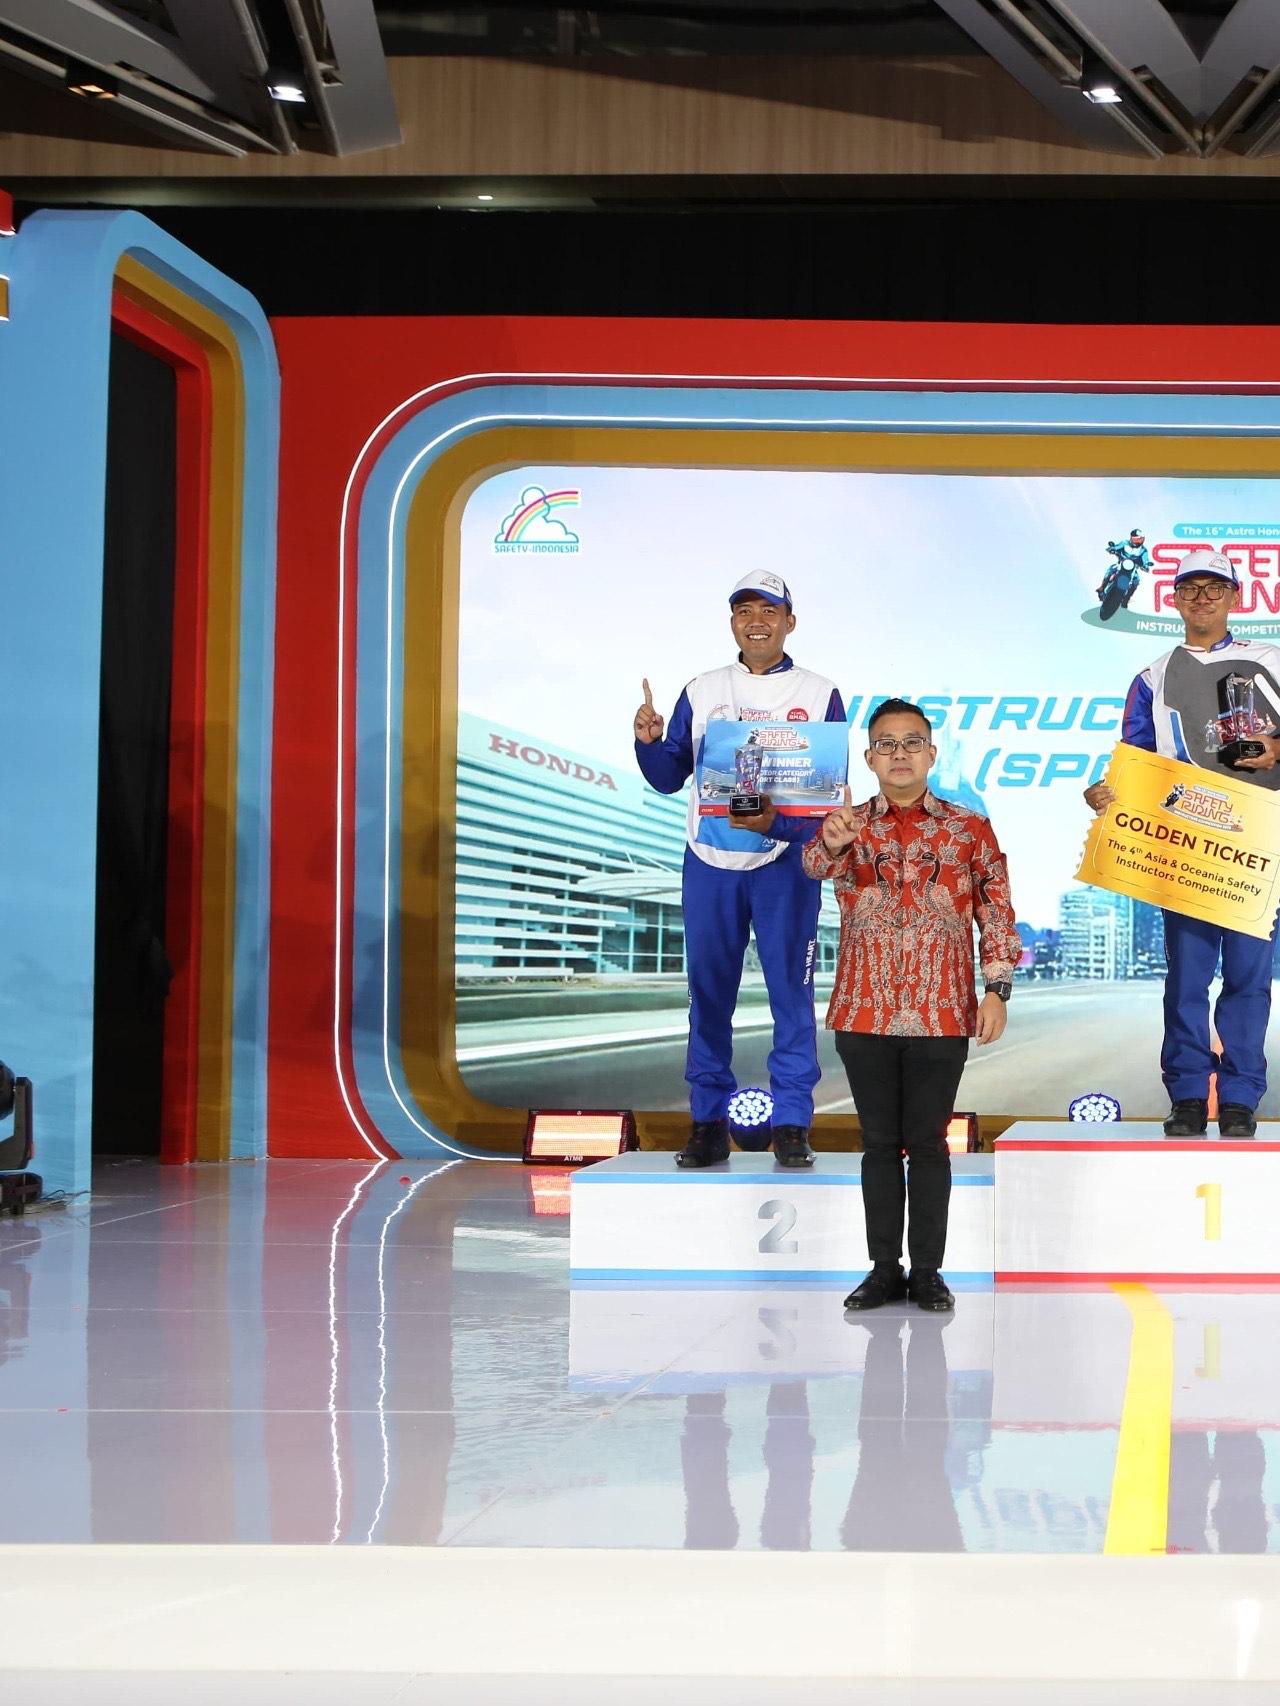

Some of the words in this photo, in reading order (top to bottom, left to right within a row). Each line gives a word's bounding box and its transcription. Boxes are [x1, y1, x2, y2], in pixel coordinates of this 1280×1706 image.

[1182, 527, 1202, 536] The
[1226, 527, 1255, 537] Astra
[1136, 620, 1187, 634] INSTRUC
[847, 696, 1125, 731] ISTRUC
[488, 733, 618, 791] HONDA
[762, 757, 812, 768] WINNER
[974, 748, 1113, 792] (SP
[1181, 800, 1230, 824] RIDING
[1184, 789, 1233, 813] SAFETY
[1115, 812, 1197, 850] GOLDEN
[1203, 839, 1271, 873] TICKET
[1107, 838, 1127, 853] The
[1129, 845, 1143, 856] 4th
[1144, 851, 1168, 866] Asia
[1170, 858, 1178, 869] &
[1180, 862, 1224, 884] Oceania
[1227, 876, 1262, 897] Safety
[1116, 855, 1175, 882] Instructors
[1177, 875, 1245, 904] Competition
[758, 1200, 798, 1253] 2
[1195, 1183, 1222, 1241] 1
